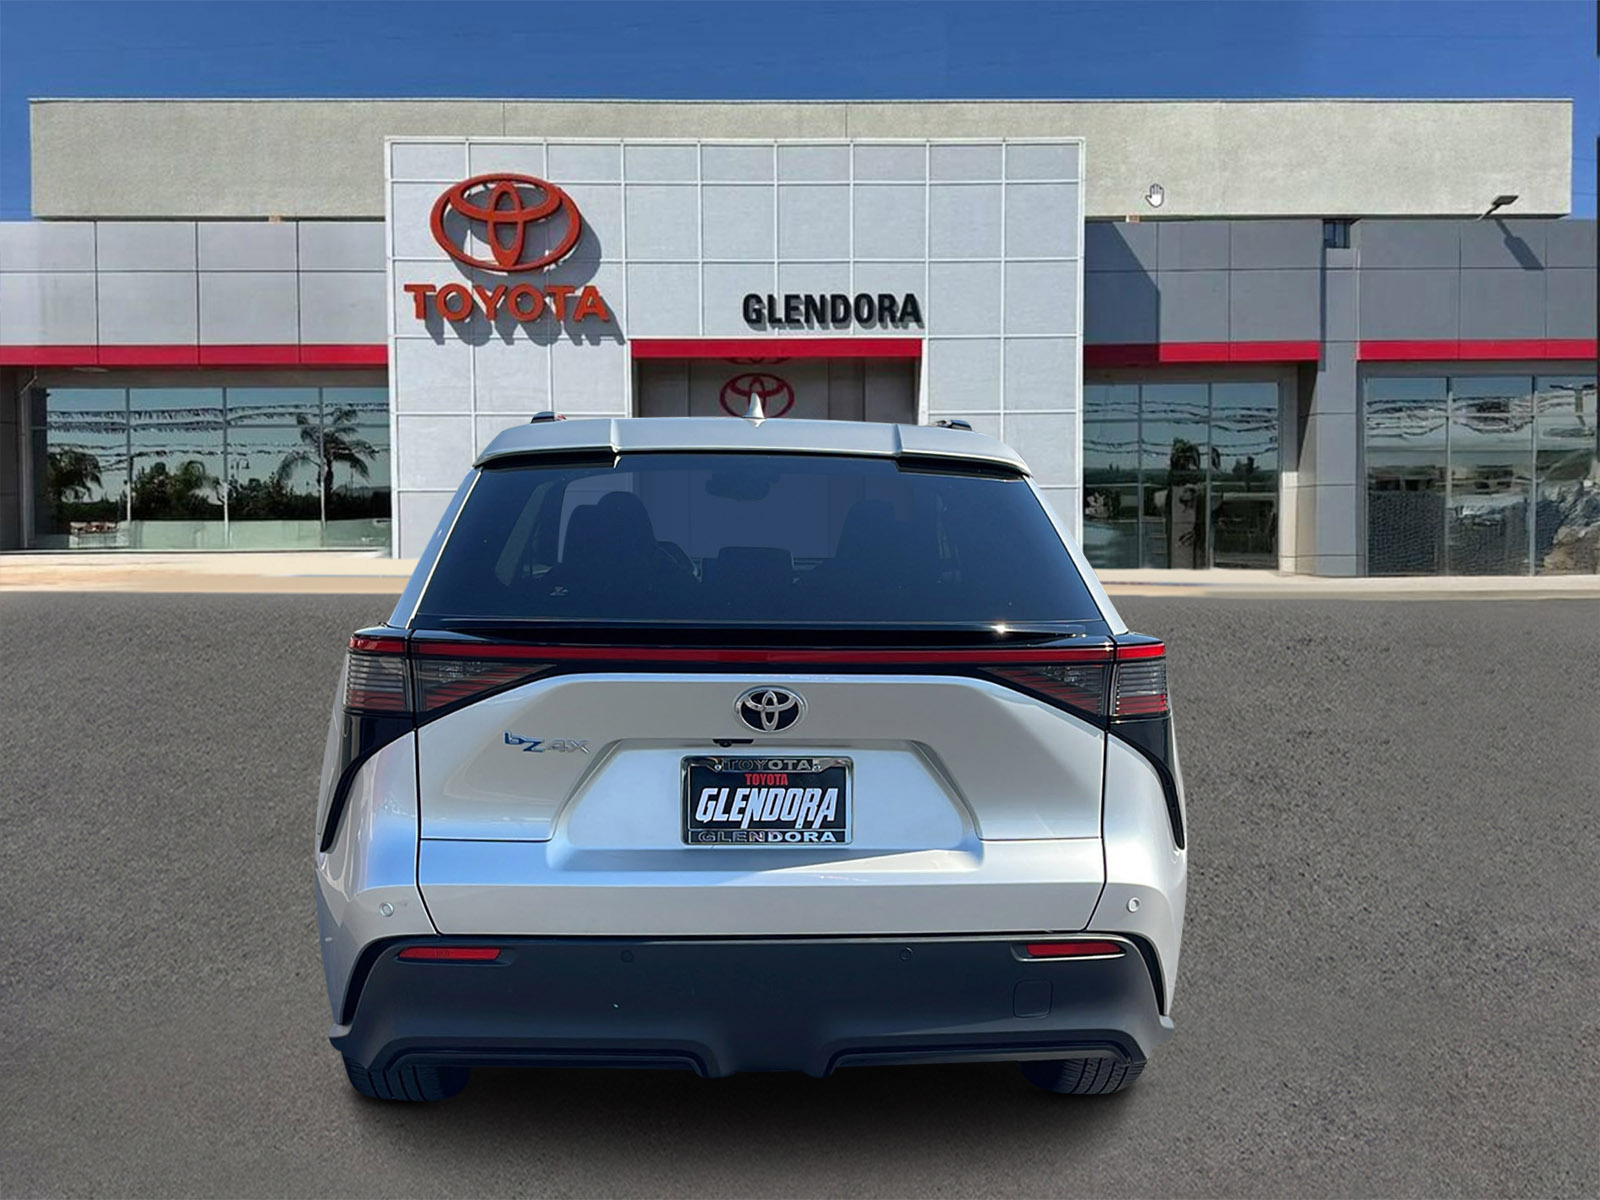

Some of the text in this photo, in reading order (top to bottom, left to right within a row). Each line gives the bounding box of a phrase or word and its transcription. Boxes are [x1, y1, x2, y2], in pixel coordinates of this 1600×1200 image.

[404, 283, 610, 324] TOYOTA
[743, 293, 924, 324] GLENDORA
[725, 760, 812, 771] TOYOTA
[745, 773, 788, 786] TOYOTA
[695, 788, 838, 829] GLENDORA
[698, 831, 836, 843] GLENDORA
